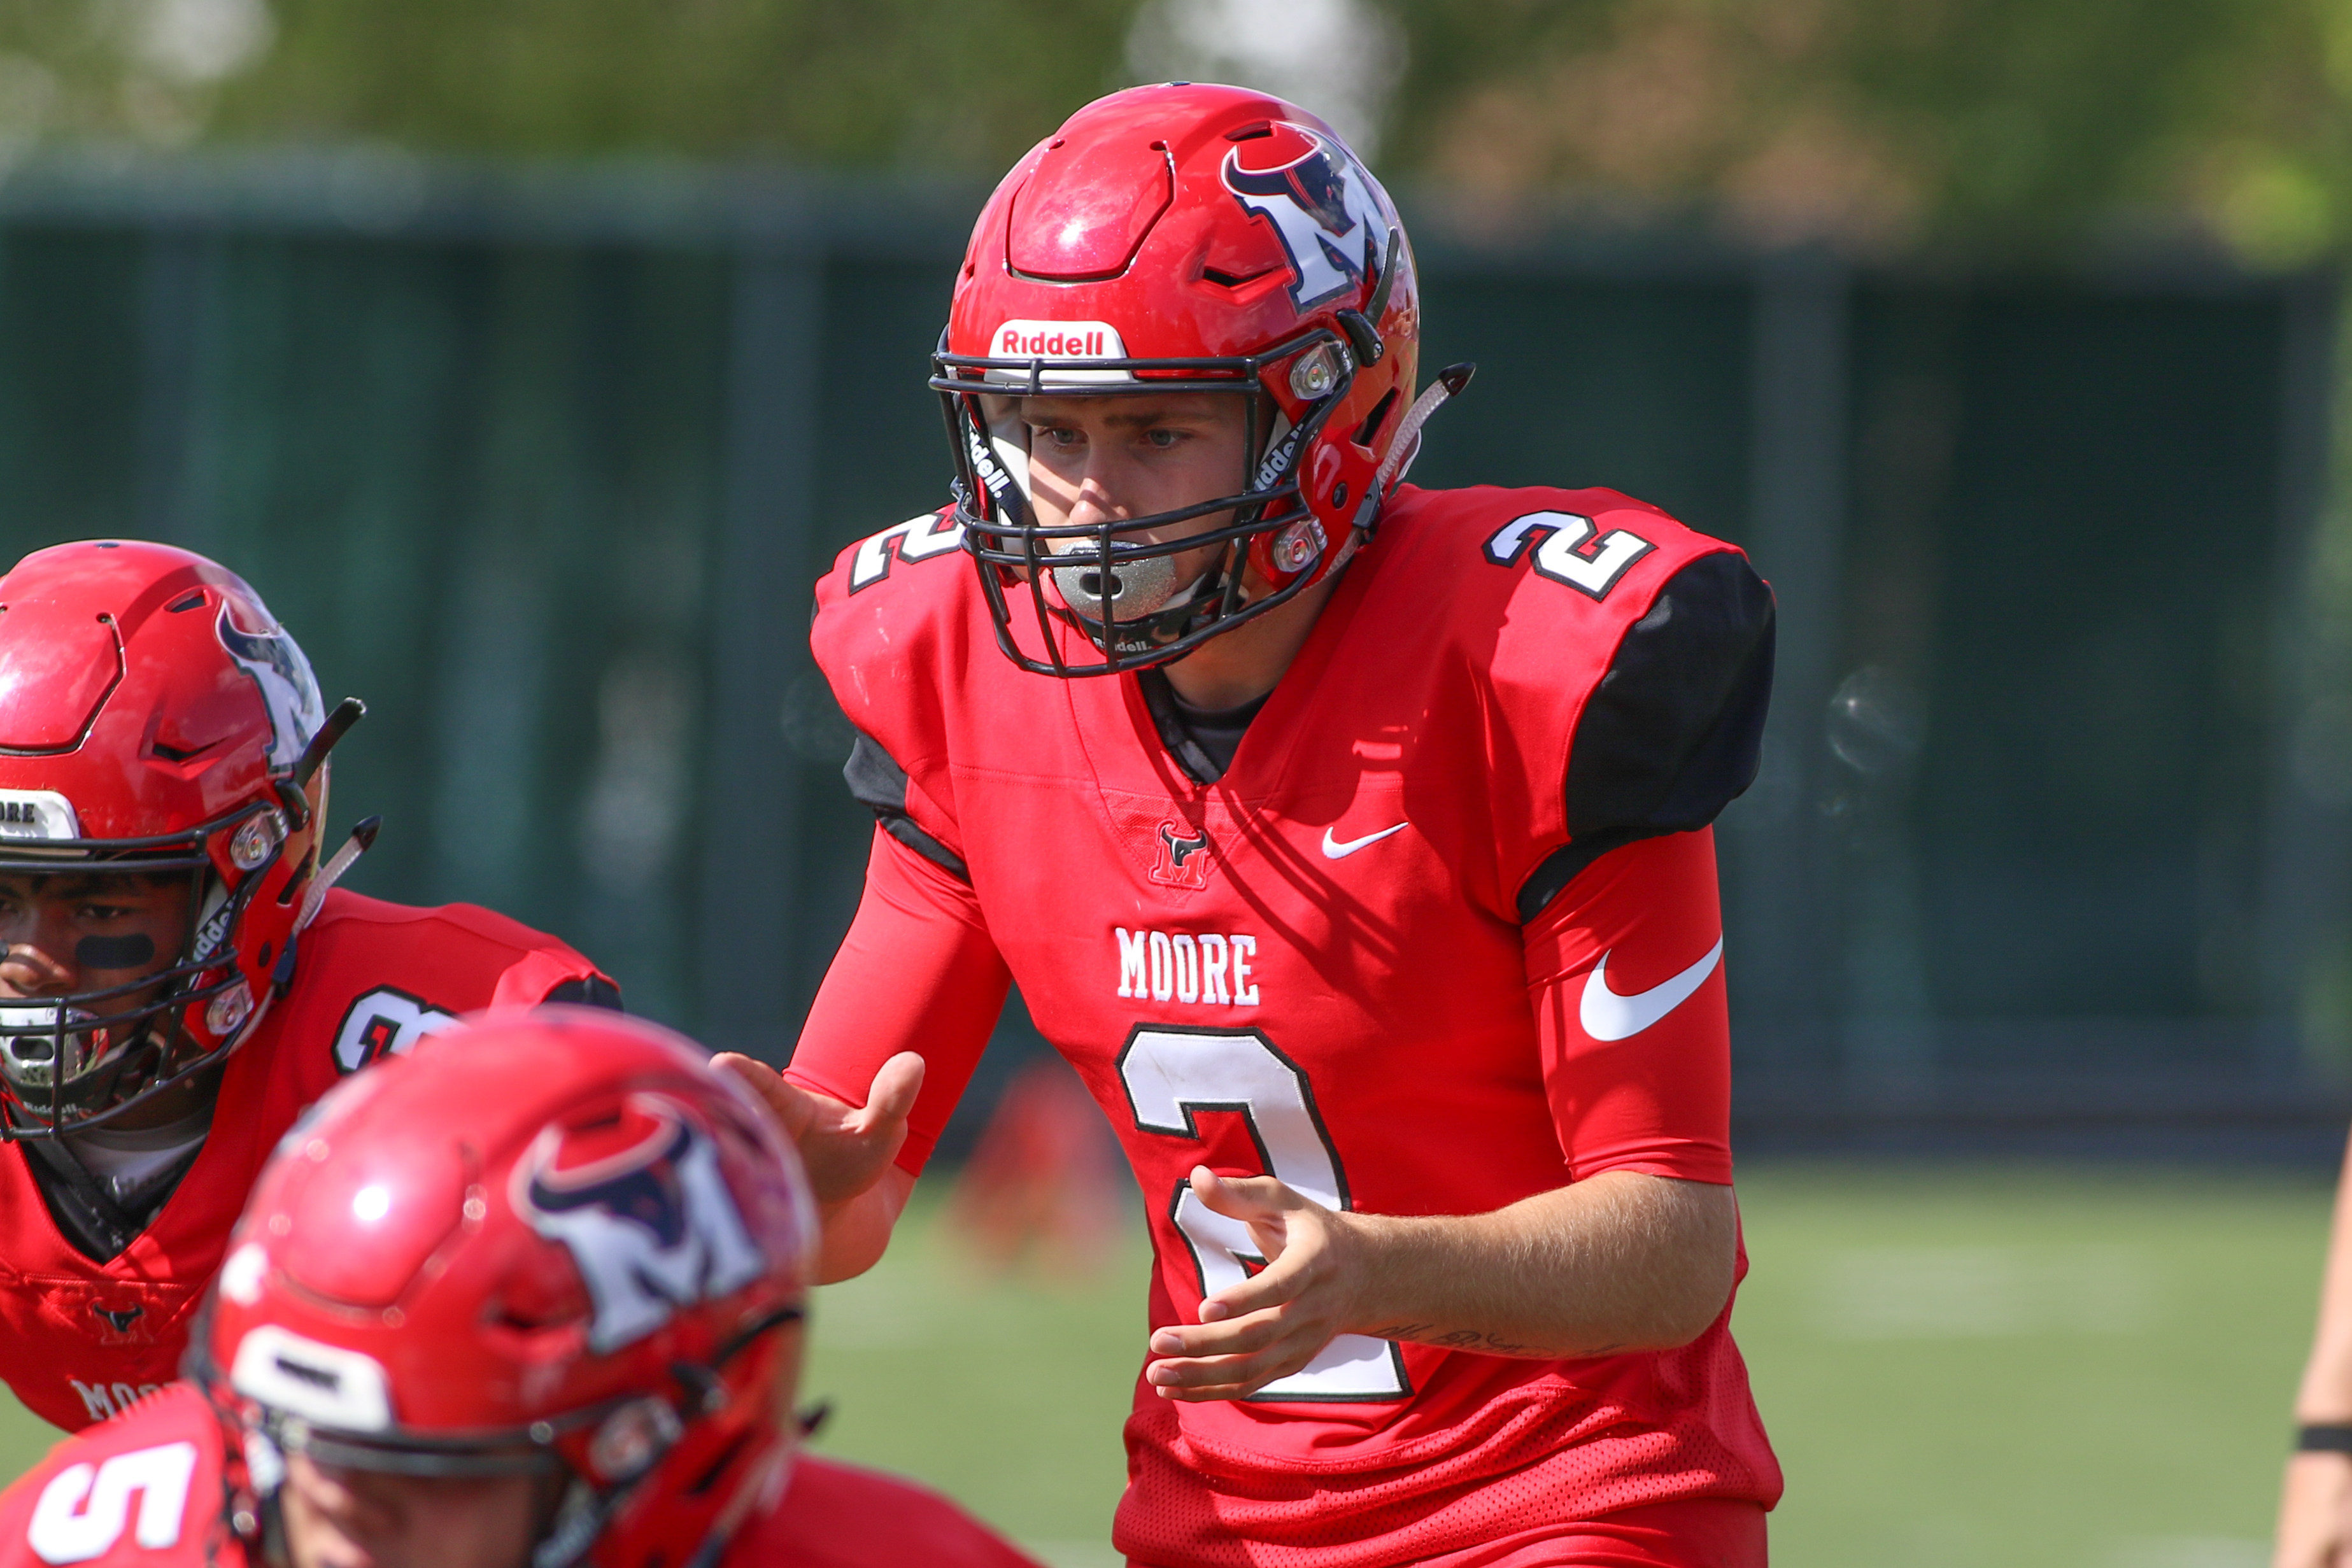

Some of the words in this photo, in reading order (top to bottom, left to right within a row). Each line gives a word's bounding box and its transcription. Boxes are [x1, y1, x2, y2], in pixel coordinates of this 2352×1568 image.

[1003, 329, 1103, 355] Riddell
[849, 511, 967, 597] 2
[1482, 509, 1657, 602] 2
[1093, 637, 1152, 652] Rdell.
[1148, 819, 1210, 889] M
[1116, 927, 1260, 1006] MOORE
[1114, 1021, 1415, 1402] 2
[28, 1441, 197, 1565] 5
